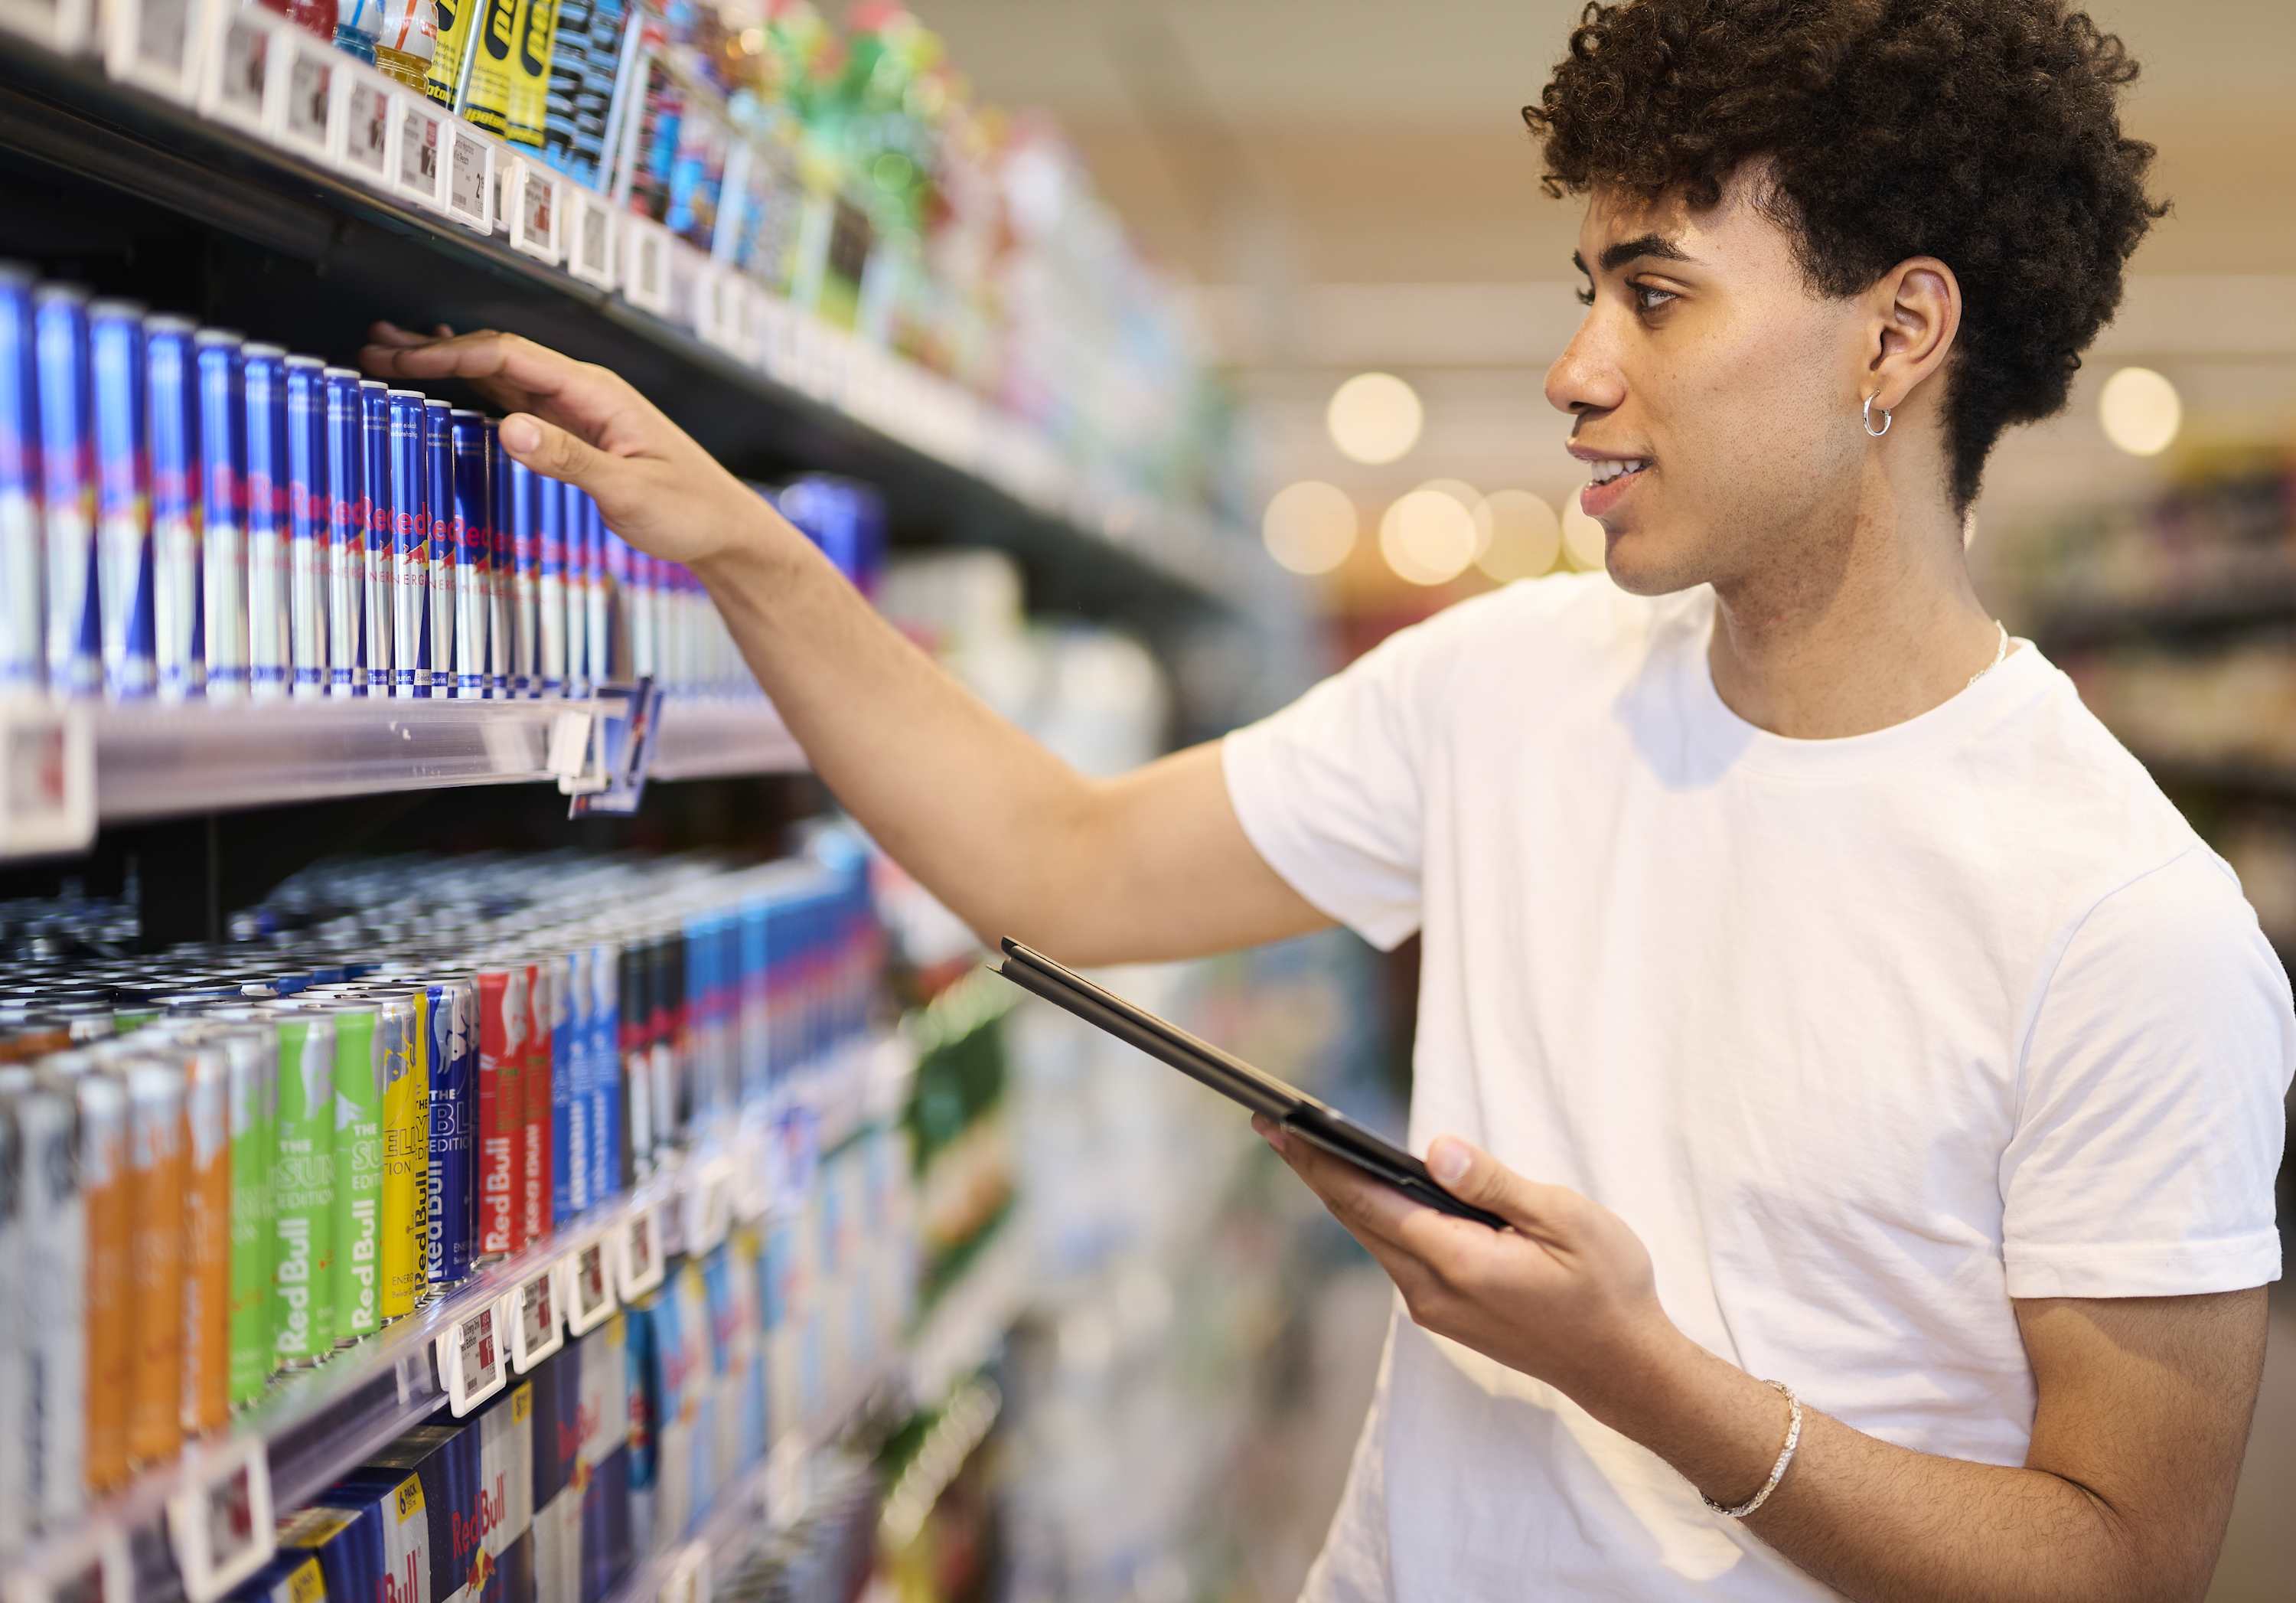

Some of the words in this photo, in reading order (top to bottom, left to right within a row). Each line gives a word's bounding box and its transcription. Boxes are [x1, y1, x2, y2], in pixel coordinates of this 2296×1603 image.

[429, 1089, 456, 1101] THE
[354, 1123, 378, 1138] THE
[485, 1137, 510, 1191] Bull
[415, 1170, 427, 1228] Bull
[485, 1194, 510, 1252] Red
[276, 1218, 310, 1284] Bull
[351, 1199, 376, 1262] Bull
[415, 1232, 427, 1291] Red
[276, 1286, 310, 1352] Red
[351, 1265, 375, 1330] Red
[452, 1494, 478, 1561] Red
[480, 1474, 505, 1536] Bull
